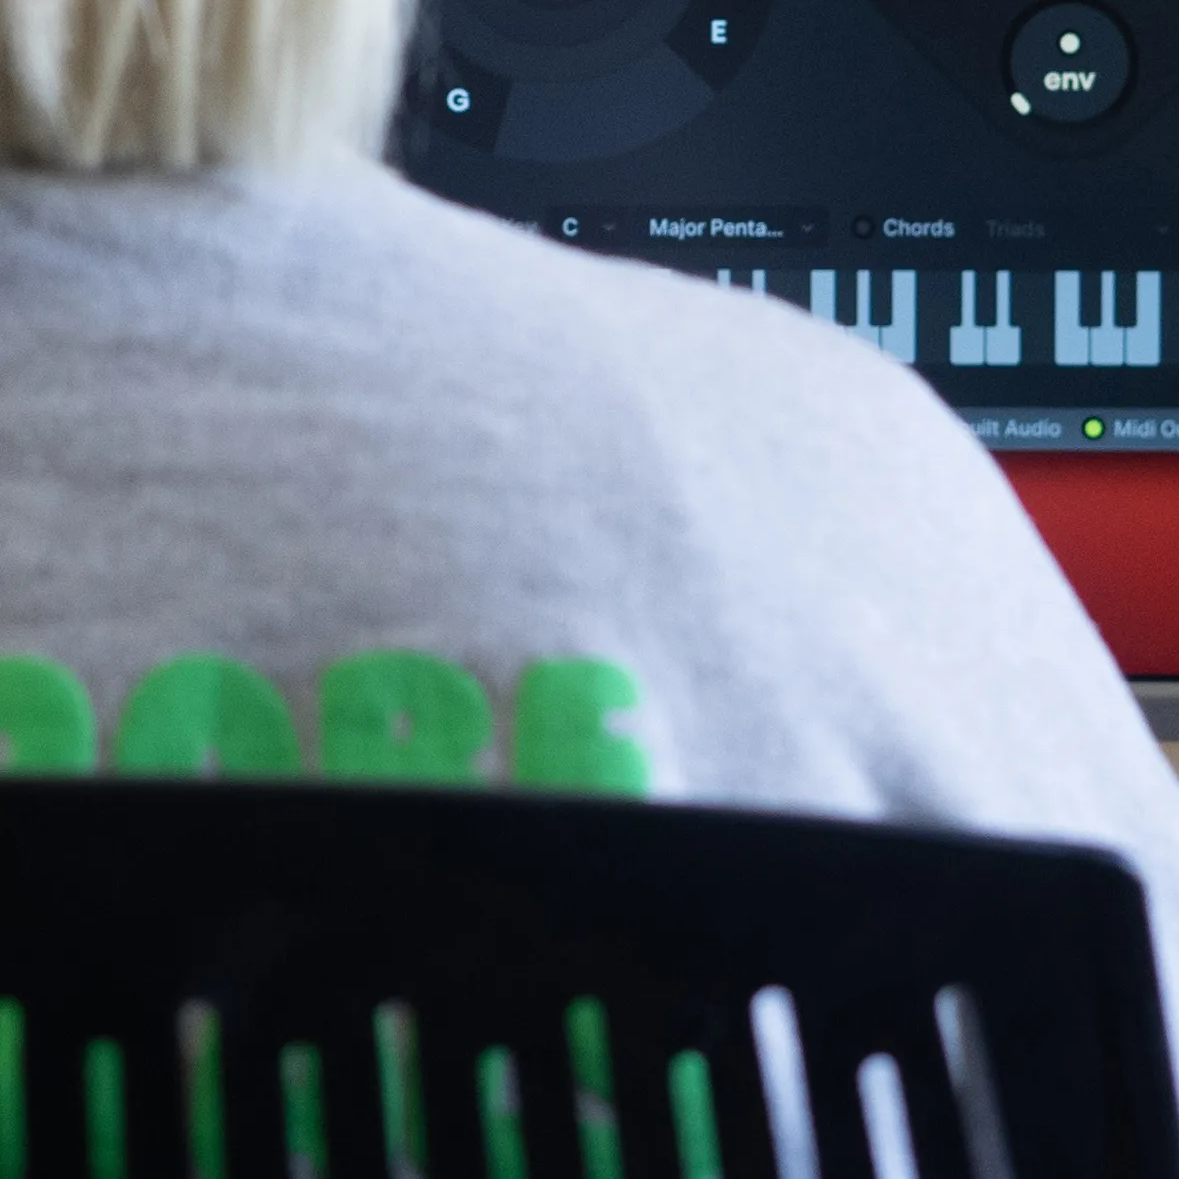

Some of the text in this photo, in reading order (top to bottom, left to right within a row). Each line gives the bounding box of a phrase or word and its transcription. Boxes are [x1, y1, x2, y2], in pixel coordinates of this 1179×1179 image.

[711, 20, 726, 43] E
[1044, 72, 1095, 91] env
[447, 88, 470, 112] G
[563, 217, 578, 236] C
[650, 218, 784, 239] Major Penta...
[883, 218, 955, 237] Chords
[1004, 420, 1062, 438] Audio
[1114, 420, 1156, 438] Midi
